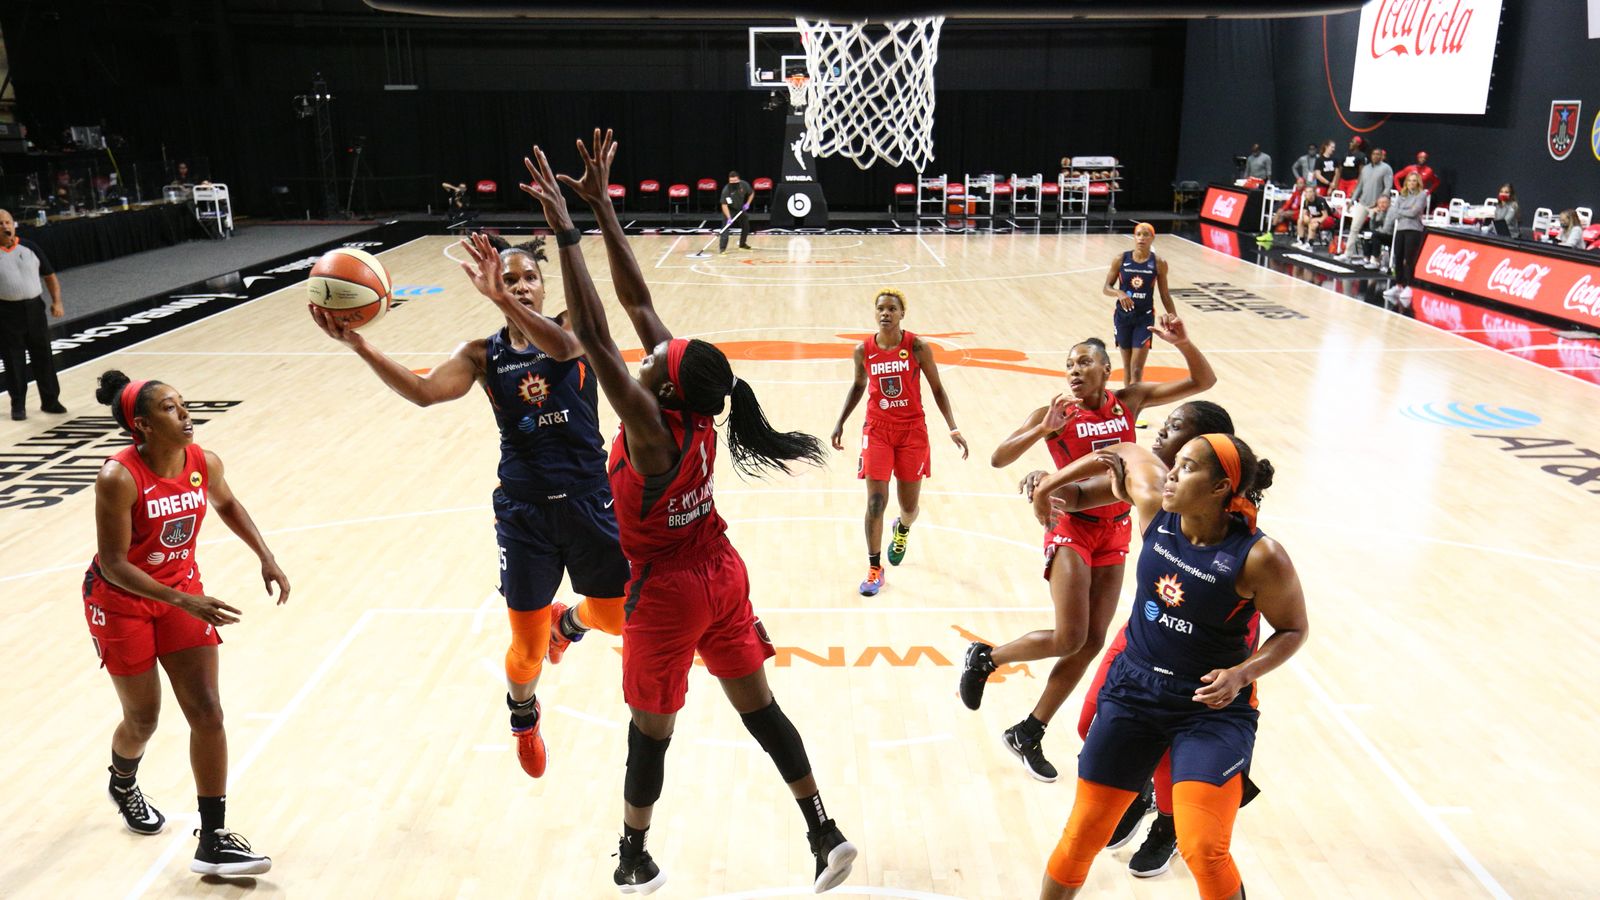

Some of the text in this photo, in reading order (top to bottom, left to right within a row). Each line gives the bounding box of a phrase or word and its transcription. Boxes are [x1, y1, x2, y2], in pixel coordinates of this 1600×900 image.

[870, 360, 910, 376] DREAM
[890, 399, 909, 409] AT&T
[538, 409, 570, 427] AT&T
[1076, 416, 1130, 439] DREAM
[1470, 434, 1600, 494] AT&
[147, 488, 205, 519] DREAM
[1158, 613, 1193, 635] AT&T
[1153, 666, 1174, 676] WNBA
